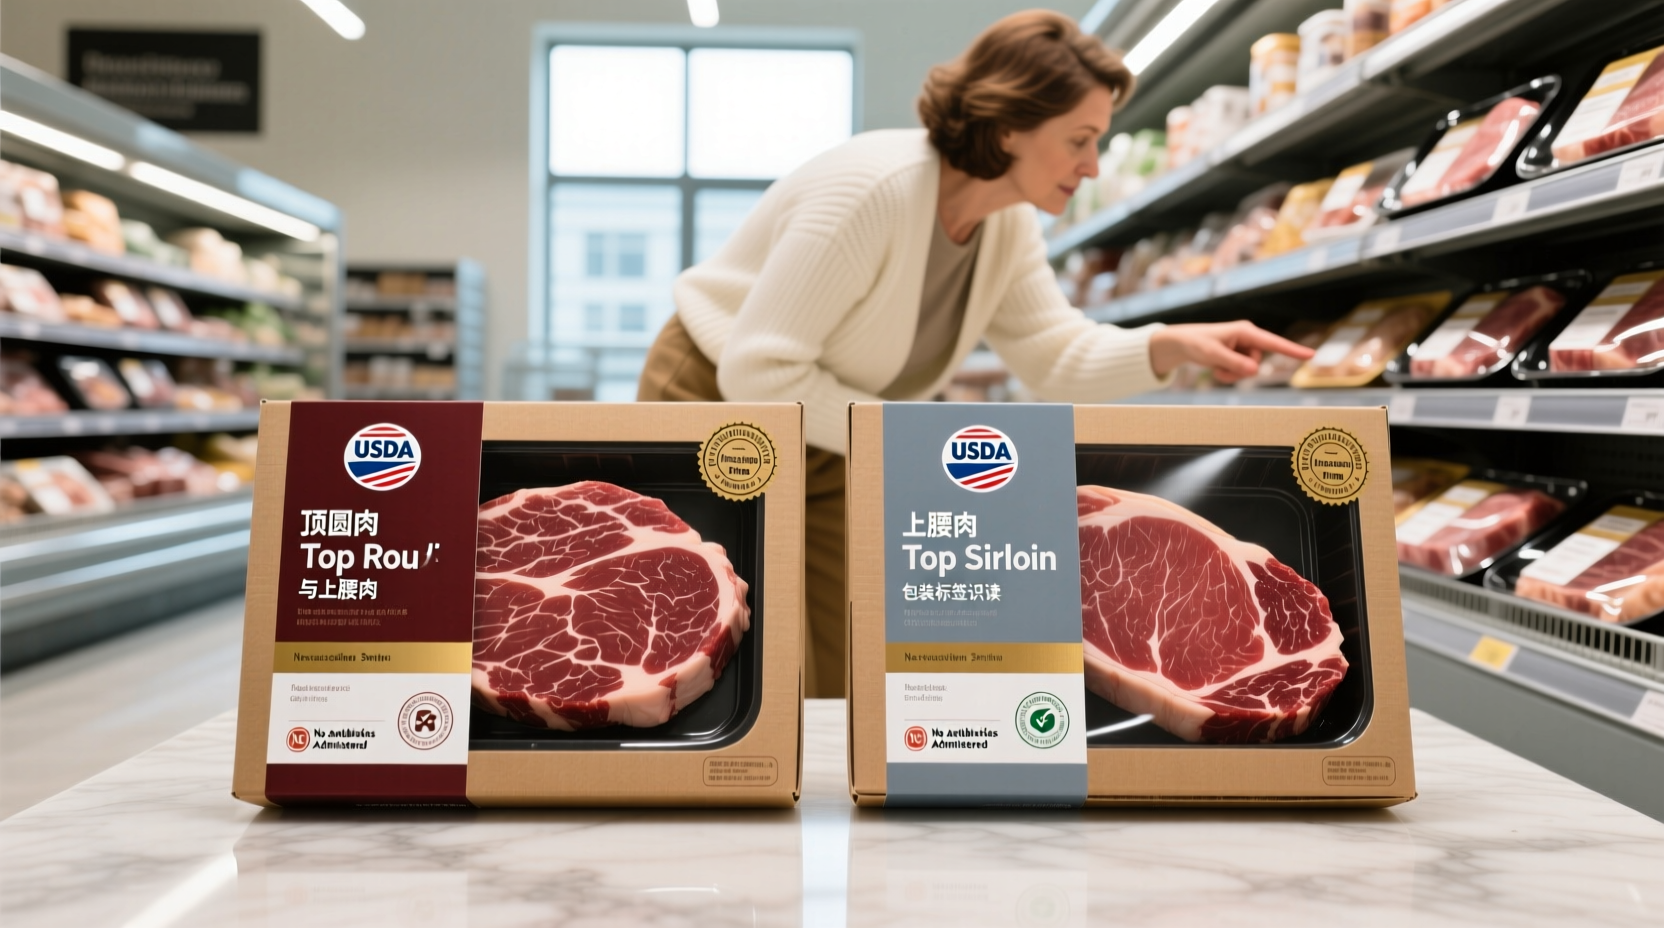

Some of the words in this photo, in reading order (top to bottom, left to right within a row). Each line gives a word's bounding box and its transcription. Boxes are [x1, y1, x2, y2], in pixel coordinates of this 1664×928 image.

[354, 440, 414, 459] USDA
[951, 441, 1012, 461] USDA
[300, 508, 379, 537] 顶圆肉
[902, 511, 977, 538] 上腰肉
[300, 543, 355, 576] Top
[902, 544, 957, 578] Top
[964, 543, 1057, 571] Sirloin
[902, 582, 1002, 602] 包装标签识读
